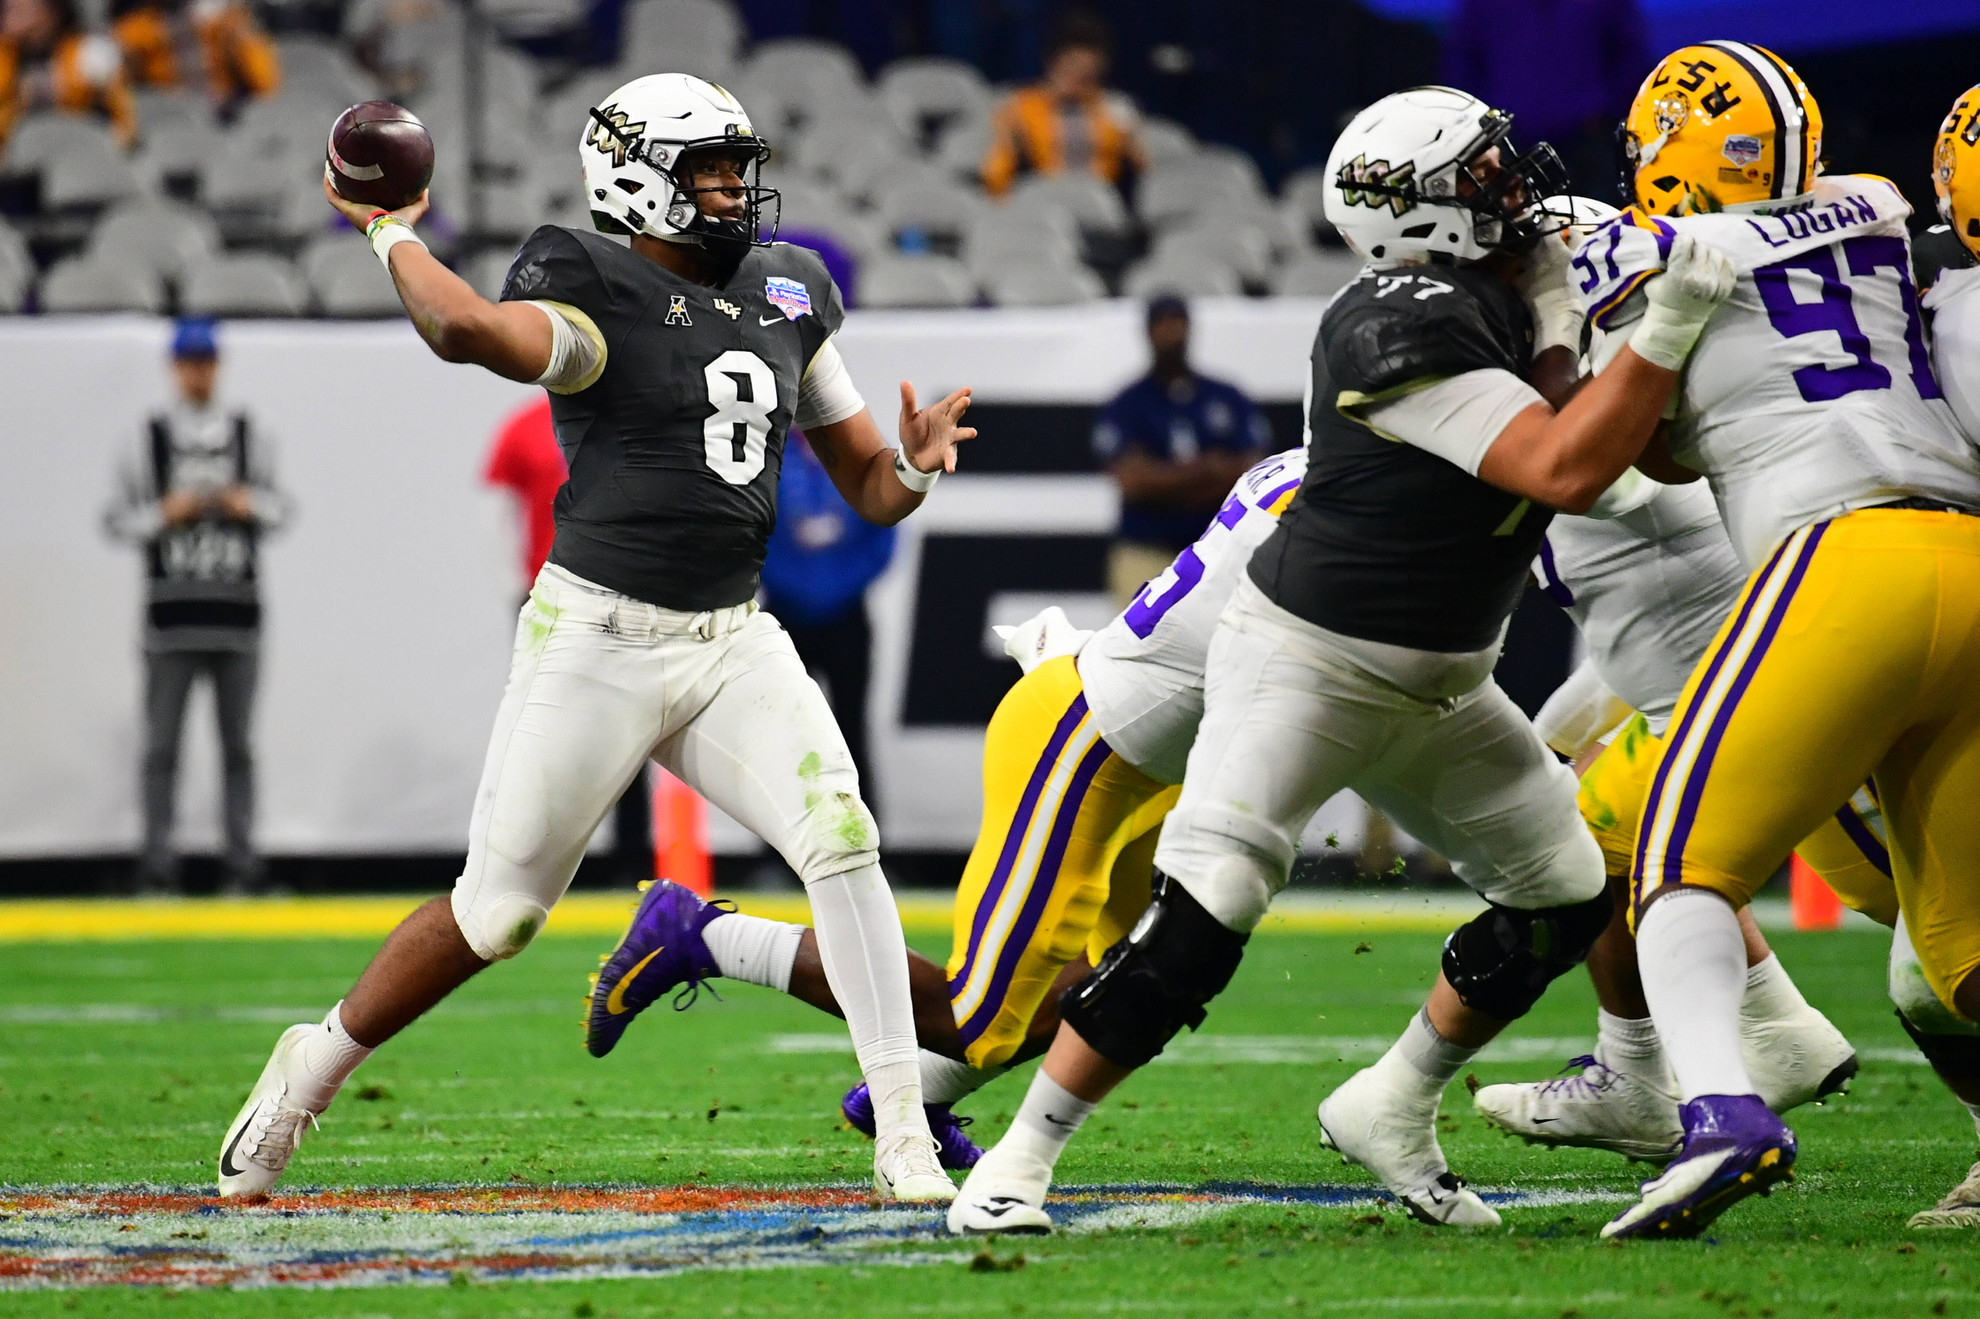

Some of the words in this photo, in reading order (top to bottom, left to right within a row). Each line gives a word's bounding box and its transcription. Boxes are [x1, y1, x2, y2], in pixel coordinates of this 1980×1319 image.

[1745, 194, 1878, 248] LOGAN
[713, 298, 742, 320] UCF
[1753, 235, 1944, 402] 97
[703, 350, 778, 486] 8
